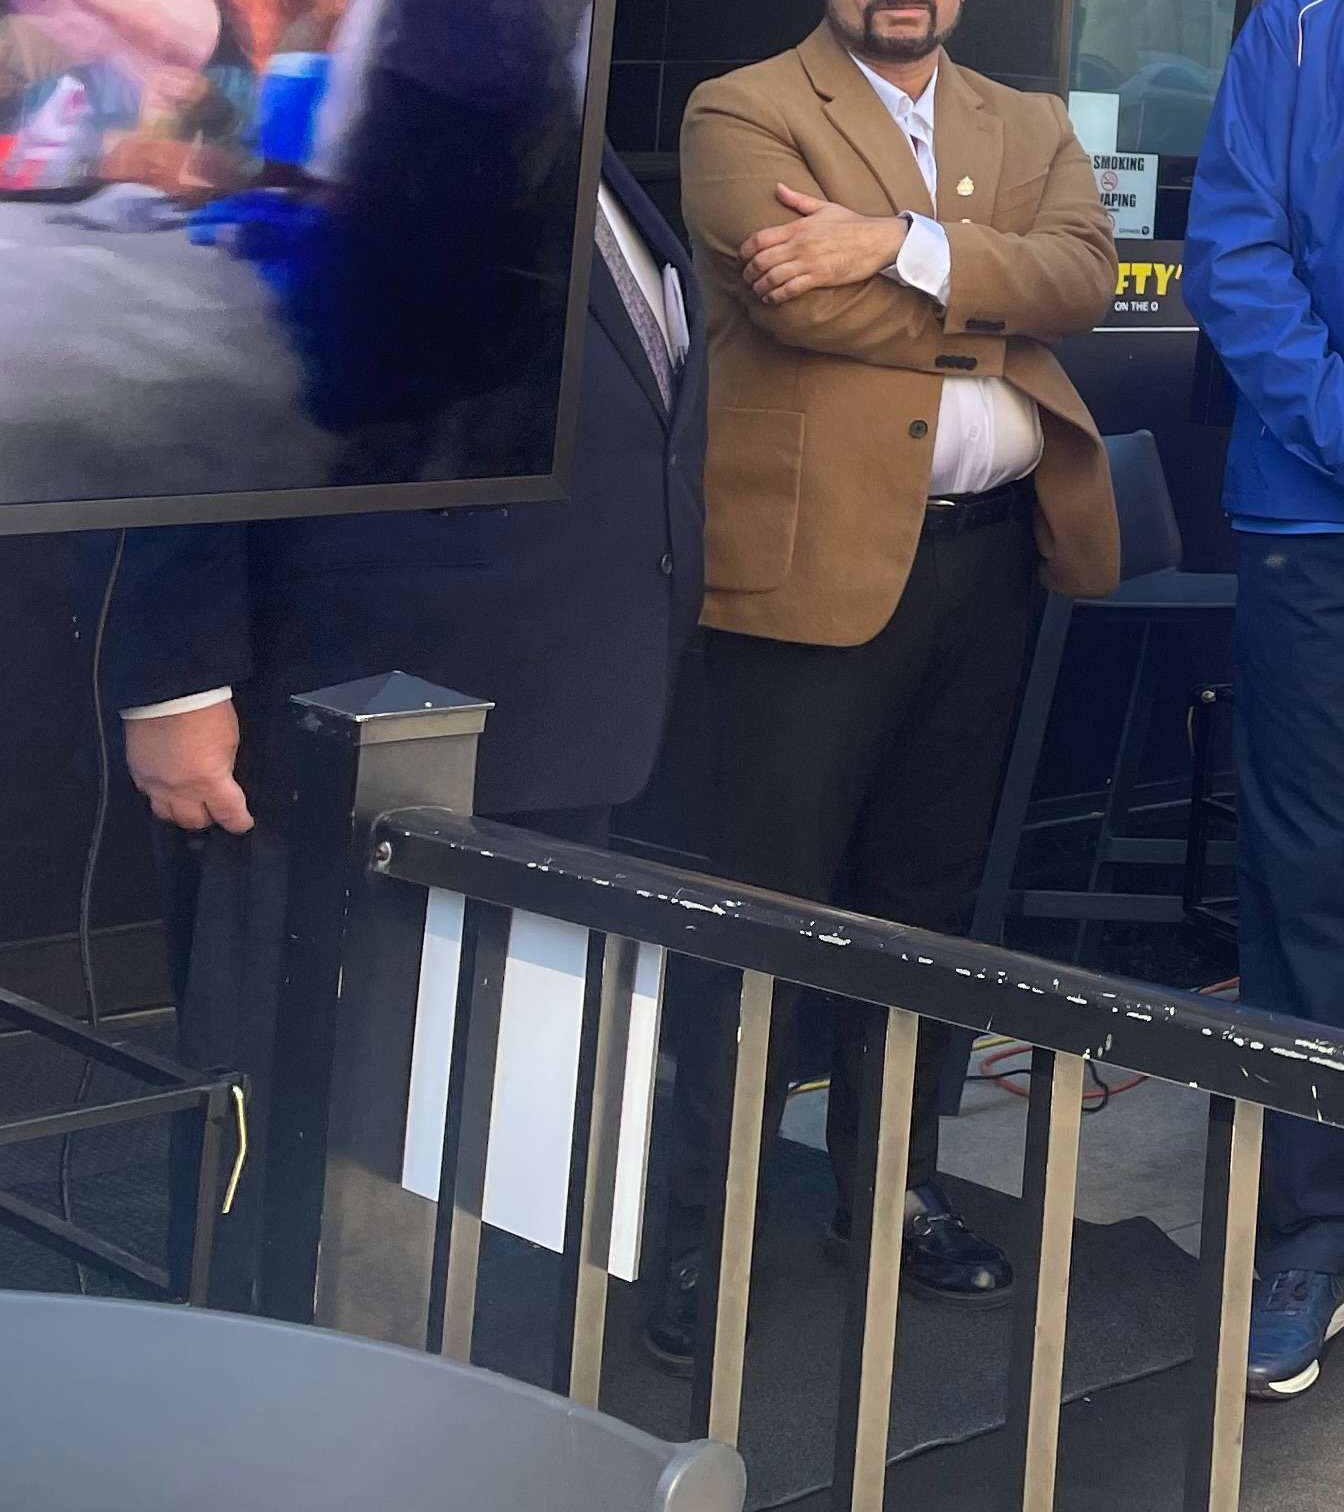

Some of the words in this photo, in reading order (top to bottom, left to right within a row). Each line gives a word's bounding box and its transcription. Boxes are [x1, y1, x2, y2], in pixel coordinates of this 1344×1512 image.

[1093, 155, 1145, 172] SMOKING
[1114, 262, 1183, 296] FTY'
[1114, 301, 1129, 312] ON
[1131, 301, 1149, 312] THE
[1150, 301, 1159, 312] O
